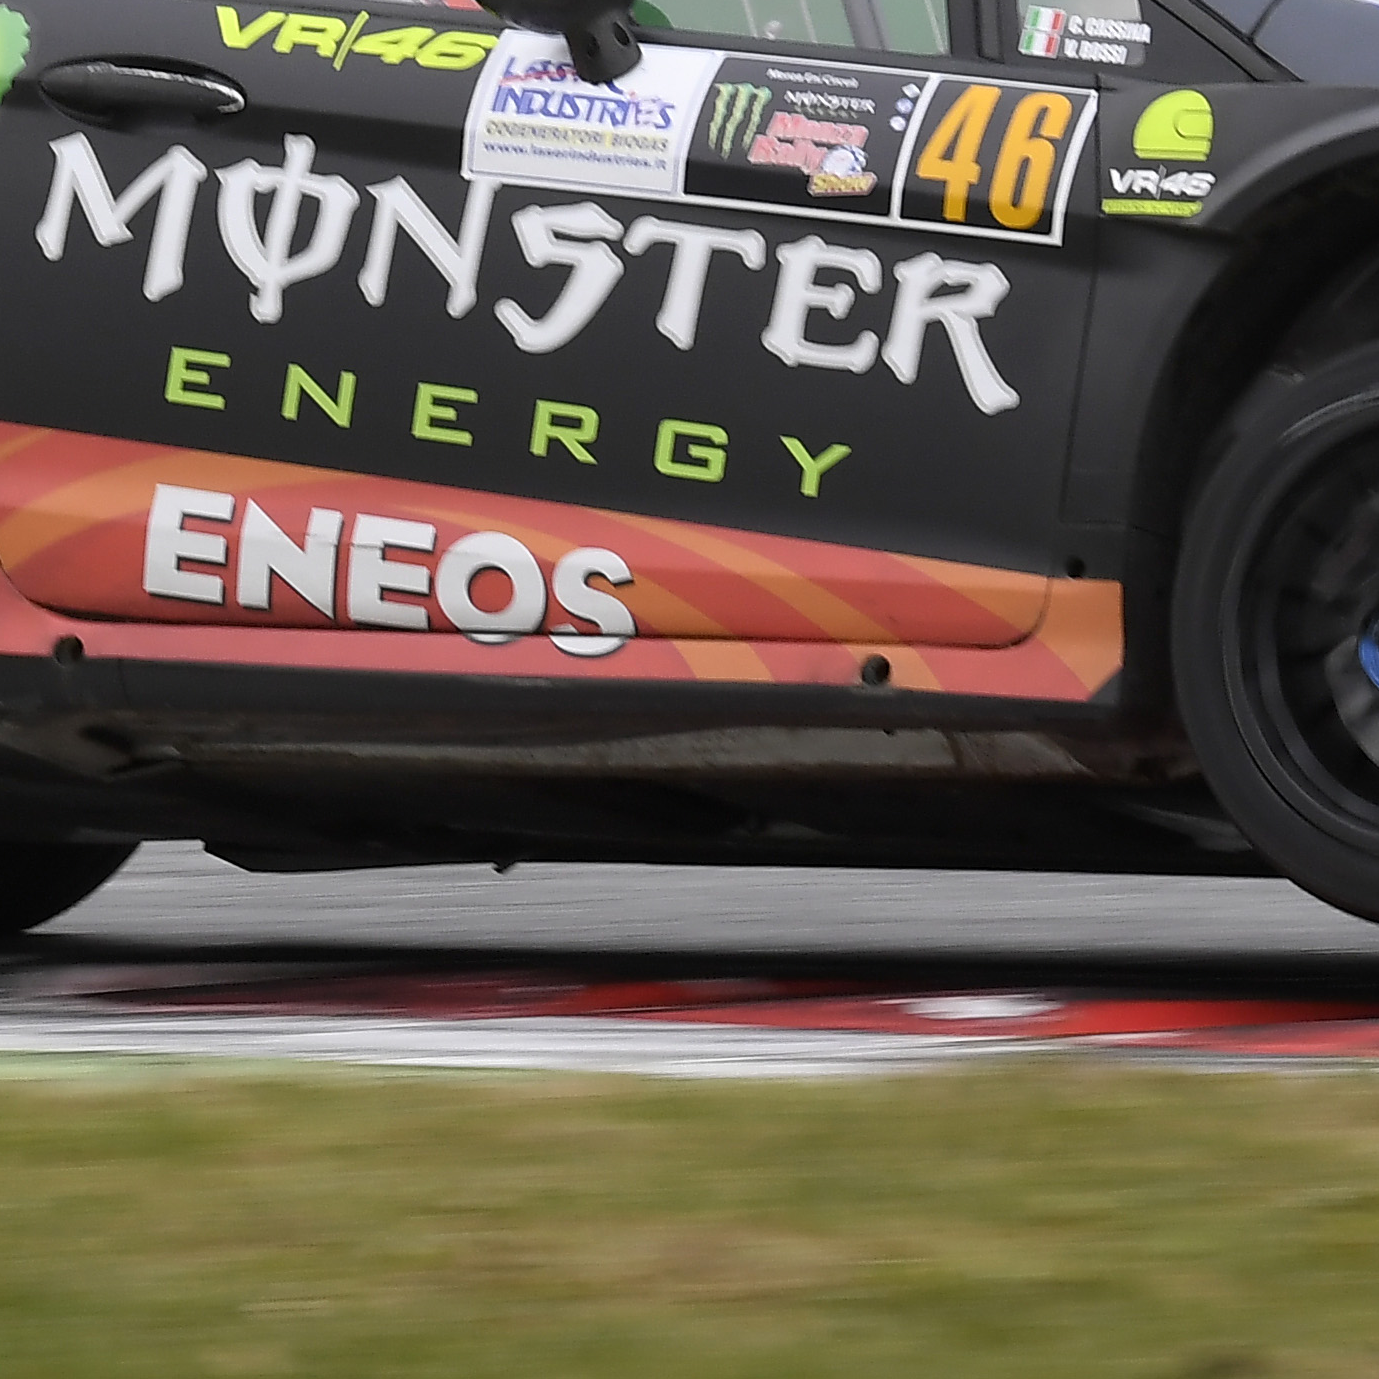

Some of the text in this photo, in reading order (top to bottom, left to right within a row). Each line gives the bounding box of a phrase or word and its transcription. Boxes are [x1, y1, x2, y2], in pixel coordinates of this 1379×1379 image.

[216, 6, 498, 71] VR/46
[492, 84, 675, 130] INDUSTRIES
[915, 84, 1074, 231] 46
[34, 131, 1019, 415] MONSTER
[163, 346, 852, 499] ENERGY
[142, 482, 638, 658] ENEOS
